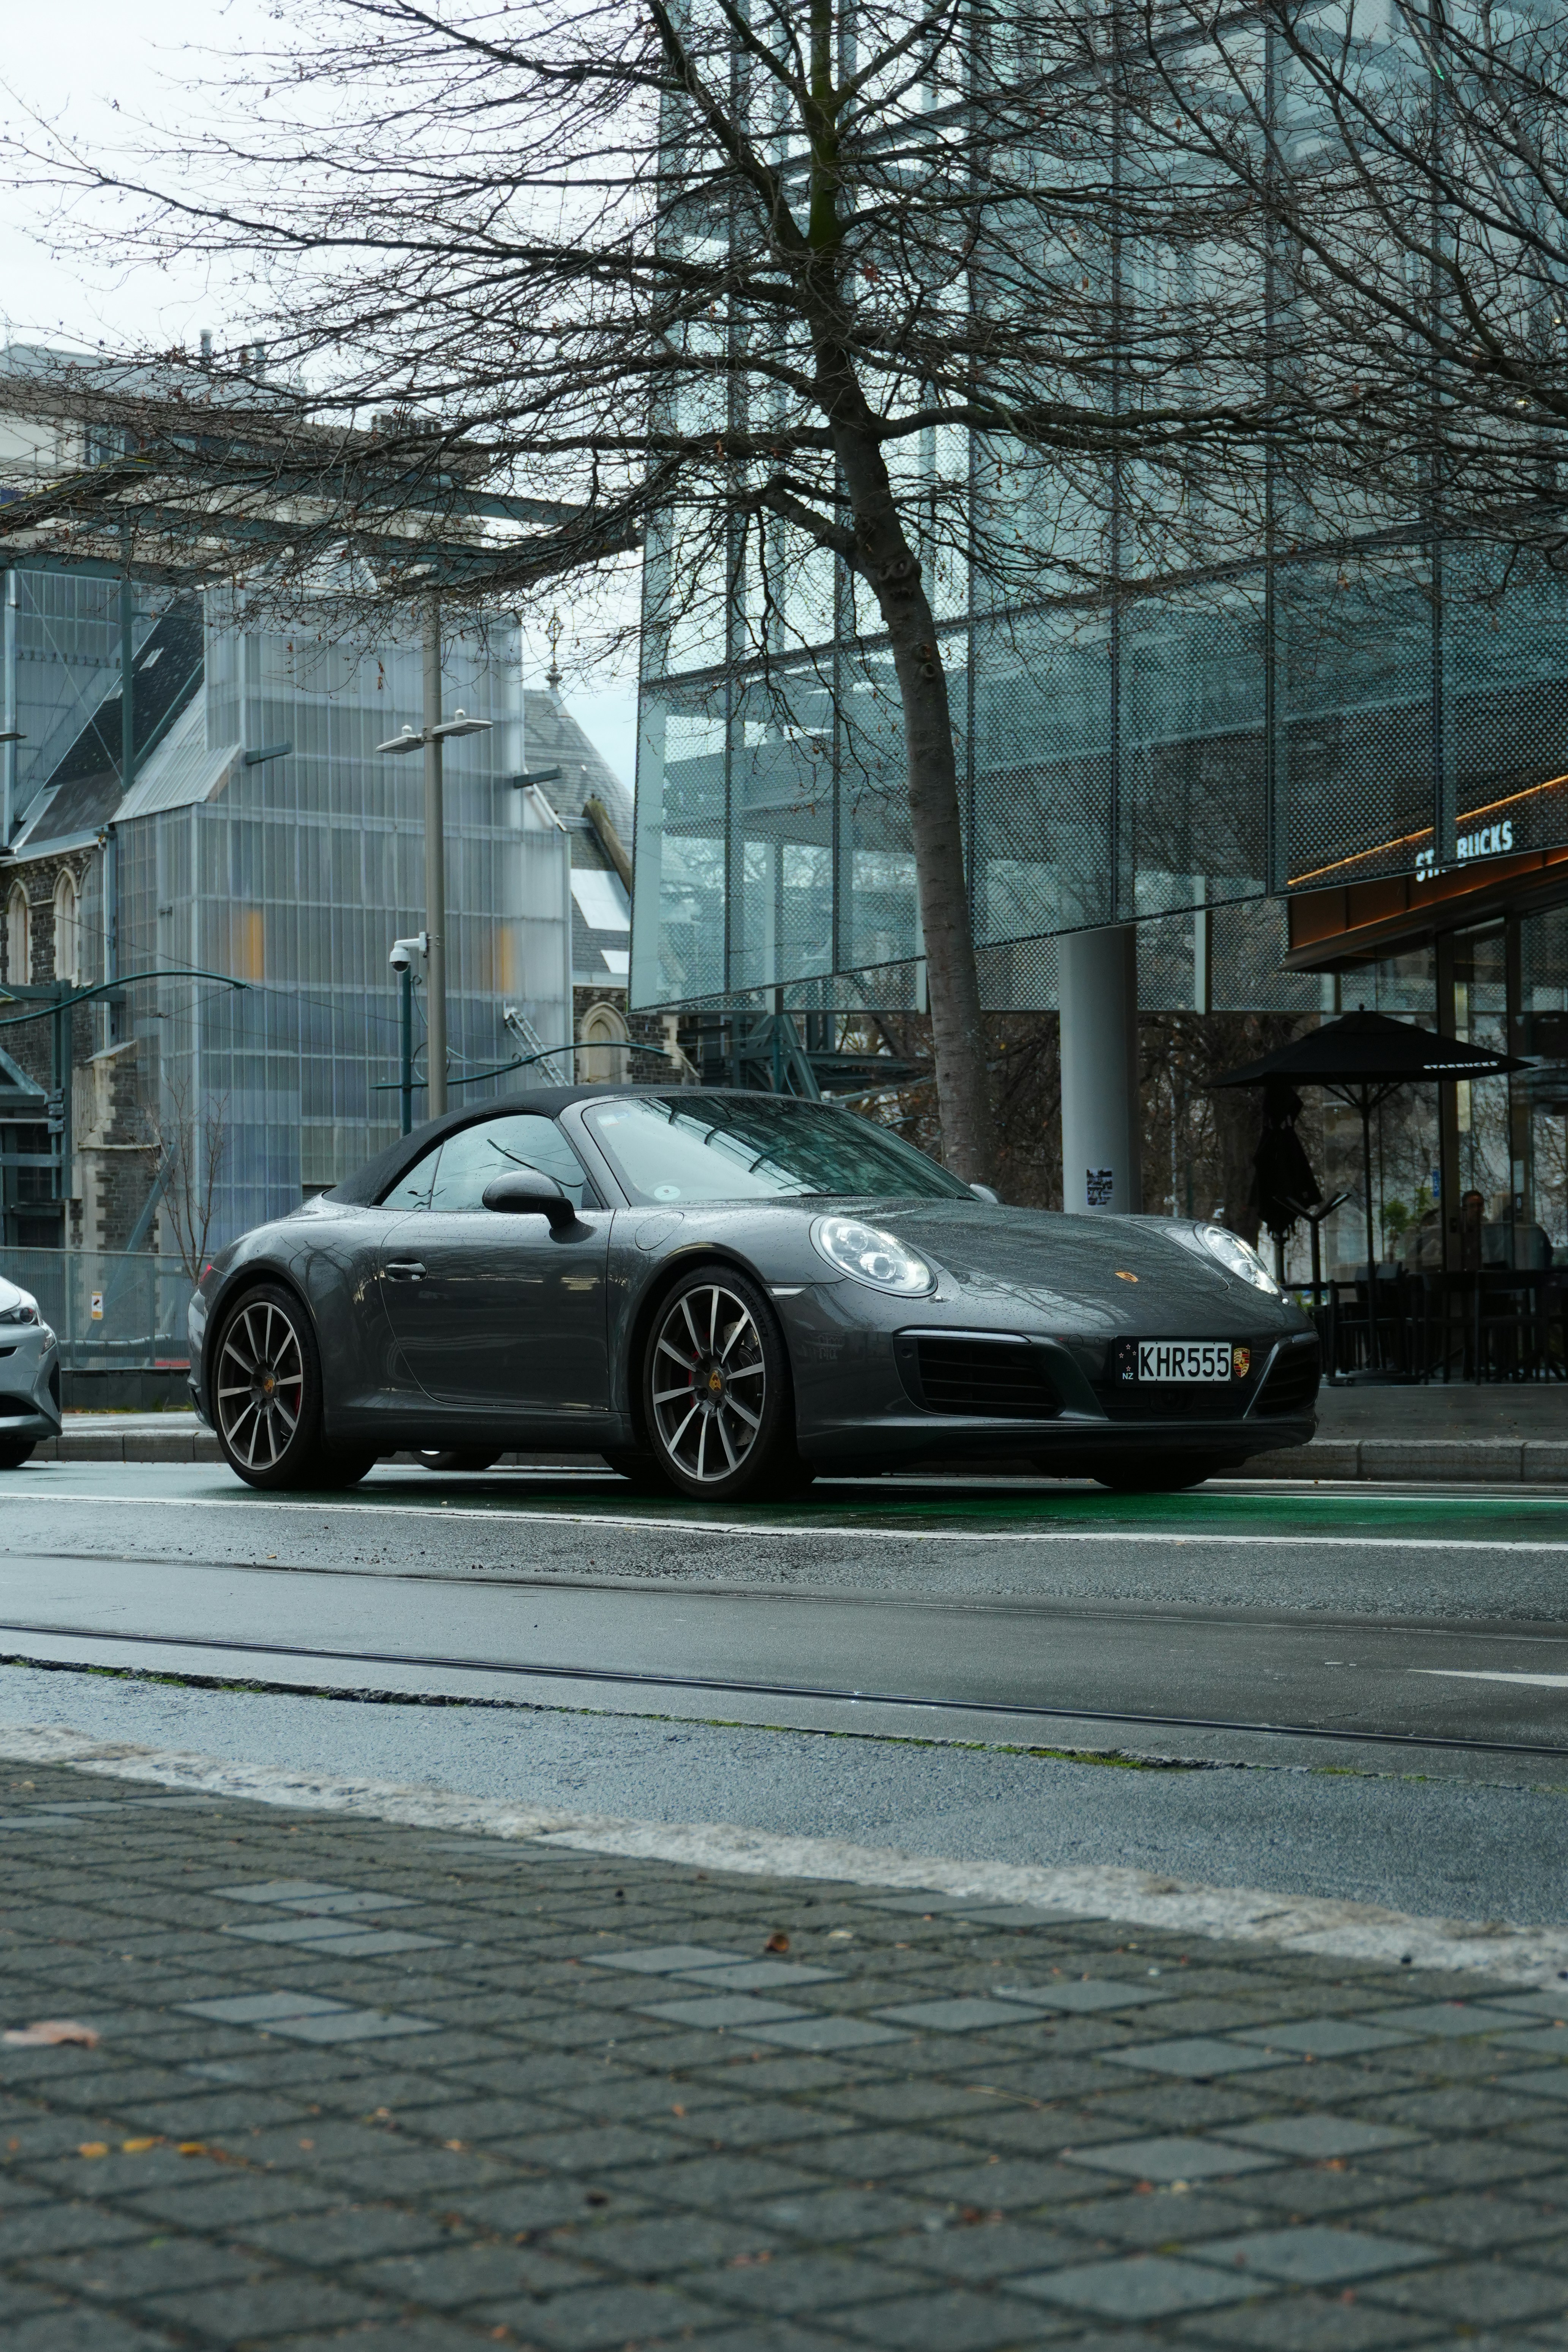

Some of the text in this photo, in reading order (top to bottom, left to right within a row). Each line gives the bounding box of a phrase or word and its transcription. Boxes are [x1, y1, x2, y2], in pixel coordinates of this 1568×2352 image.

[1415, 820, 1513, 882] STBUCKS
[1423, 1061, 1498, 1069] STARBUCKS
[1140, 1347, 1229, 1377] KHR555
